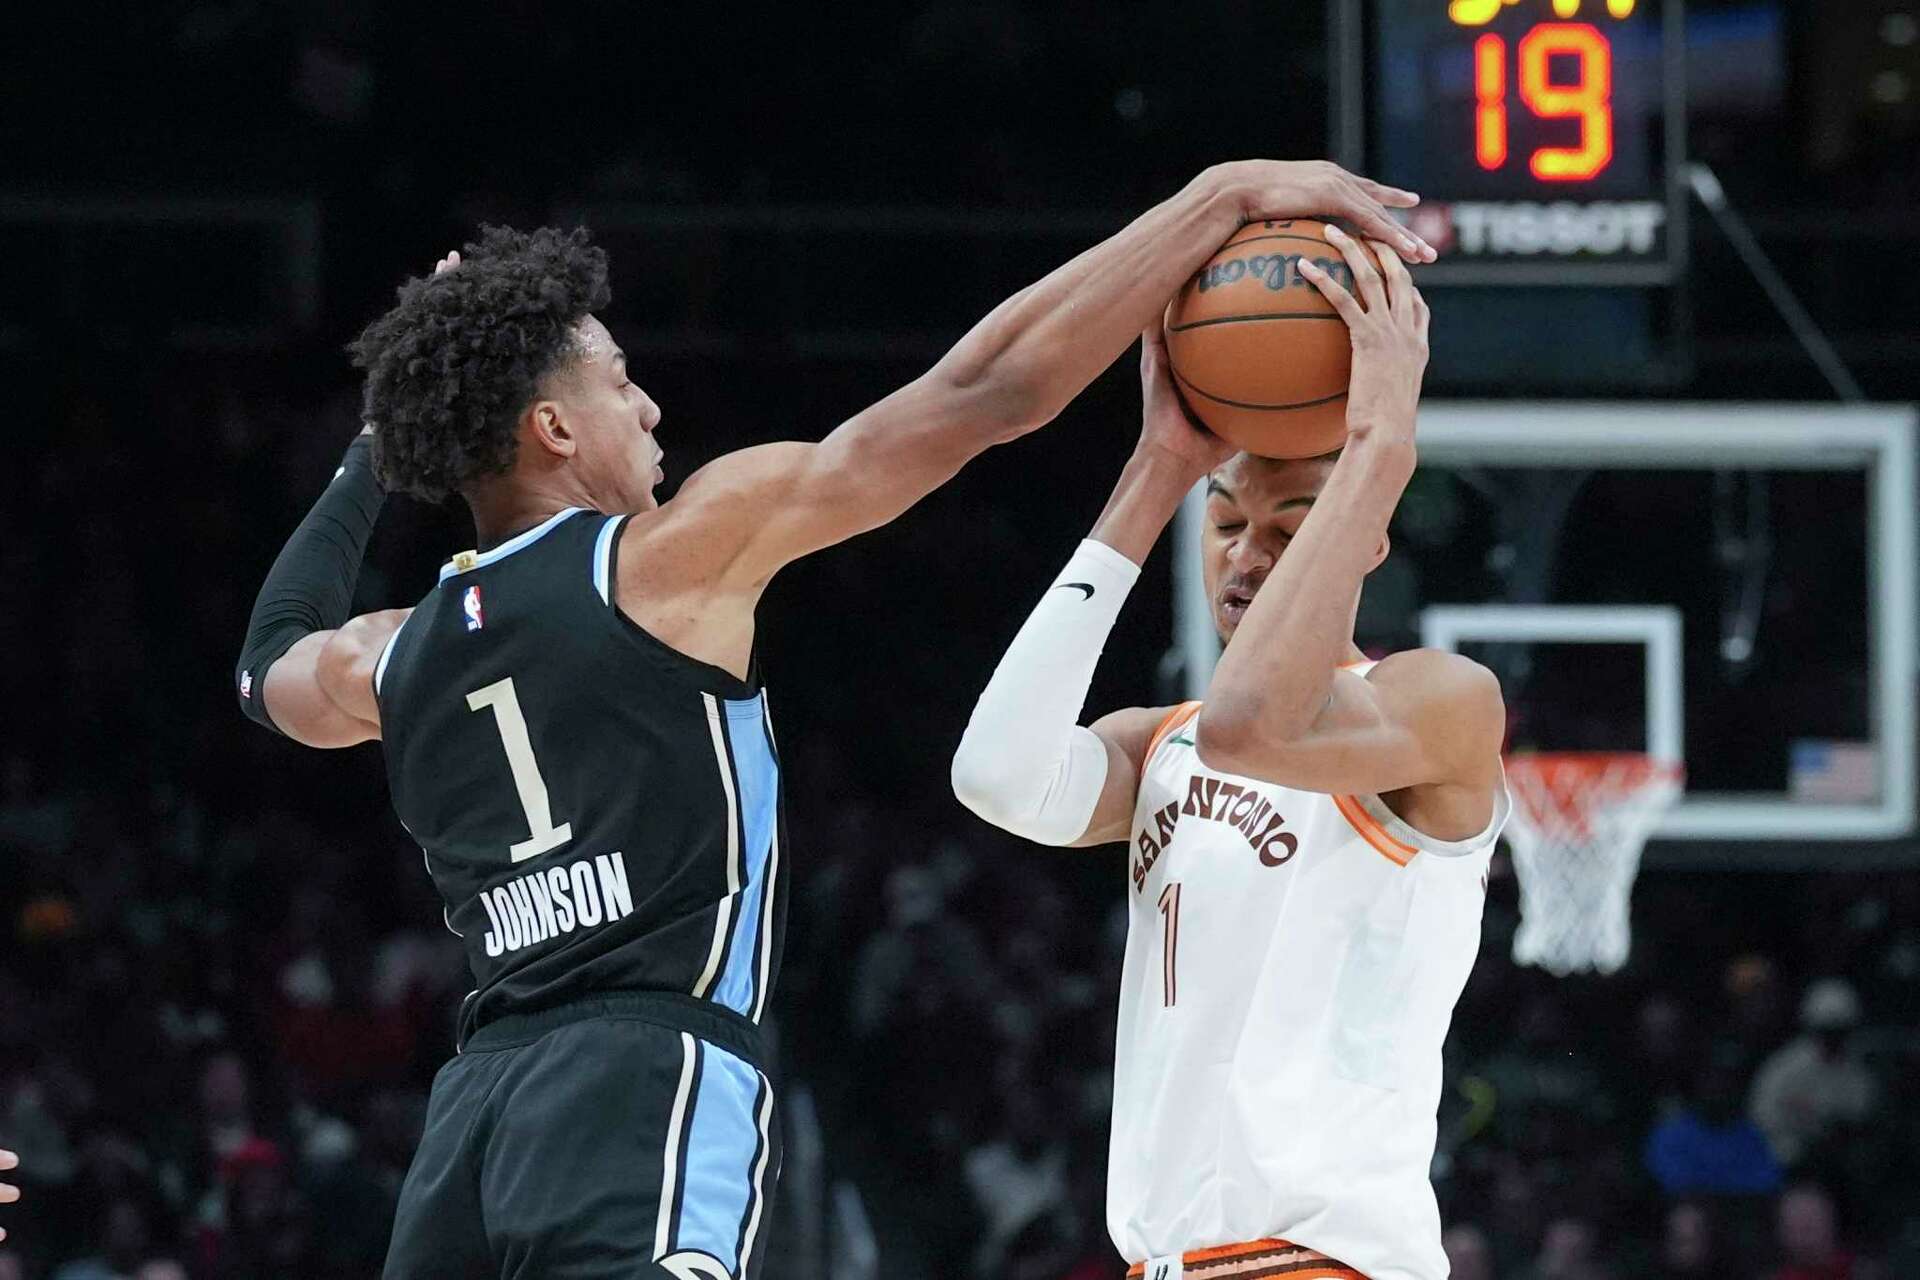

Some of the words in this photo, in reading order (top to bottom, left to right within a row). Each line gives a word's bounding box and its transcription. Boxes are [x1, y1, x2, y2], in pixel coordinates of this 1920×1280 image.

[1474, 22, 1614, 183] 19
[1453, 200, 1664, 255] TISSOT
[465, 676, 573, 863] 1
[1181, 775, 1299, 868] NTONIO
[479, 851, 634, 958] JOHNSON
[1157, 881, 1182, 1008] 1
